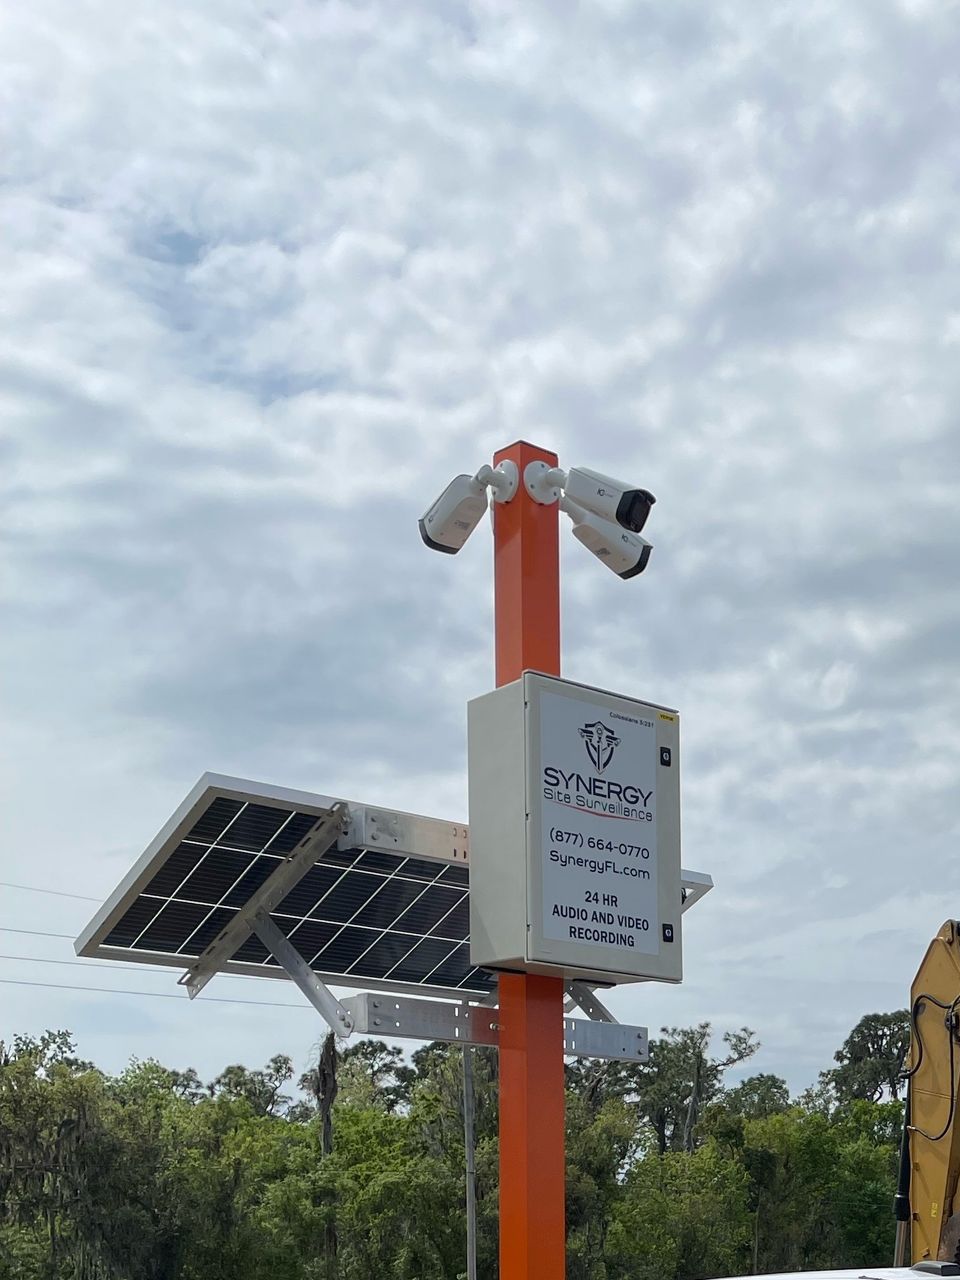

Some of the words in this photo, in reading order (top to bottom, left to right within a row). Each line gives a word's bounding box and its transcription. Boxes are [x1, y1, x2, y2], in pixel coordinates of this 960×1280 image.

[544, 767, 653, 808] SYNERGY
[543, 787, 571, 804] Site
[576, 794, 653, 822] Surveillance
[550, 827, 584, 848] (877)
[587, 837, 650, 860] 664-0770
[550, 850, 650, 880] SynergyFL.com
[585, 891, 600, 905] 24
[602, 893, 618, 908] HR
[552, 904, 588, 921] AUDIO
[591, 910, 615, 925] AND
[617, 914, 649, 931] VIDEO
[569, 926, 635, 948] RECORDING
